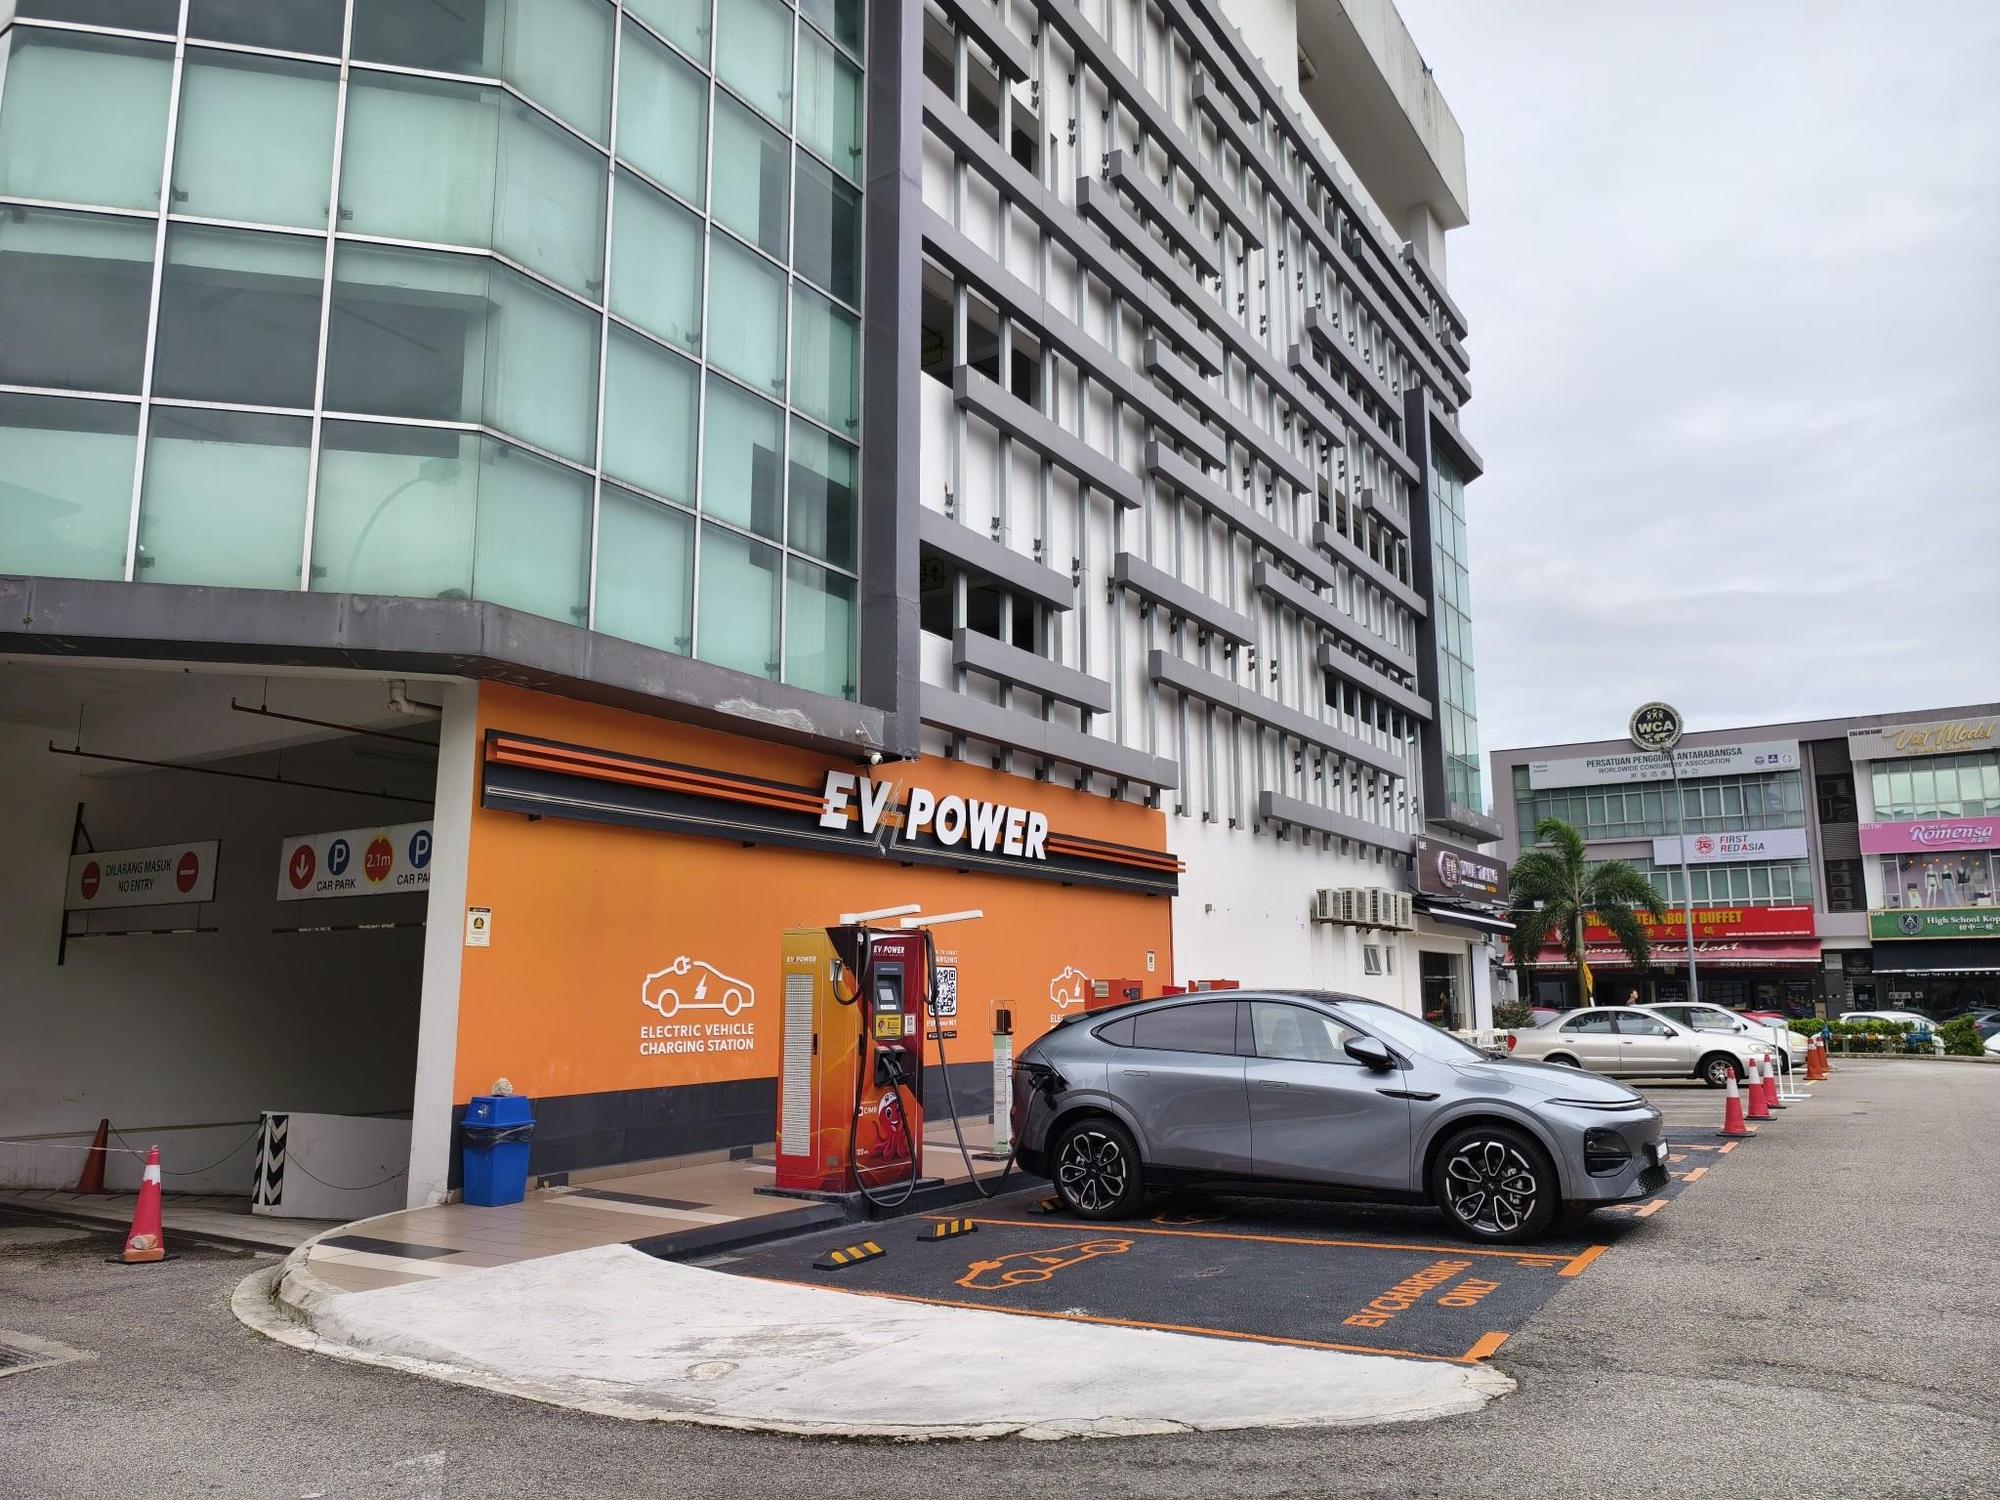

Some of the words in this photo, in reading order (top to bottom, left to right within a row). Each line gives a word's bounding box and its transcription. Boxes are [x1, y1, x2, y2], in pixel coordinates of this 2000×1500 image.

[1638, 720, 1674, 734] WCA
[1586, 756, 1632, 768] PERSATUAN
[1677, 747, 1743, 760] ANTARABANGSA
[1598, 765, 1638, 774] WORLDWIDE
[1685, 757, 1731, 767] ASSOCIATION
[819, 769, 893, 834] EV
[905, 787, 1049, 860] POWER
[1720, 834, 1749, 844] FIRST
[1910, 824, 1993, 842] Romensa
[105, 861, 143, 877] DILARANG
[144, 858, 172, 873] MASUK
[366, 854, 391, 868] 2.1m
[117, 880, 130, 893] NO
[130, 878, 155, 892] ENTRY
[316, 880, 333, 892] CAR
[334, 877, 356, 890] PARK
[396, 873, 415, 885] CAR
[417, 873, 430, 884] PA
[1700, 910, 1743, 924] BUFFET
[1927, 916, 1948, 926] High
[1950, 915, 1980, 924] School
[883, 946, 905, 954] POWER
[795, 955, 817, 963] POWER
[640, 1024, 702, 1039] ELECTRIC
[704, 1023, 755, 1036] VEHICLE
[639, 1040, 705, 1056] CHARGING
[707, 1038, 754, 1052] STATION
[1437, 1278, 1502, 1308] ONLY
